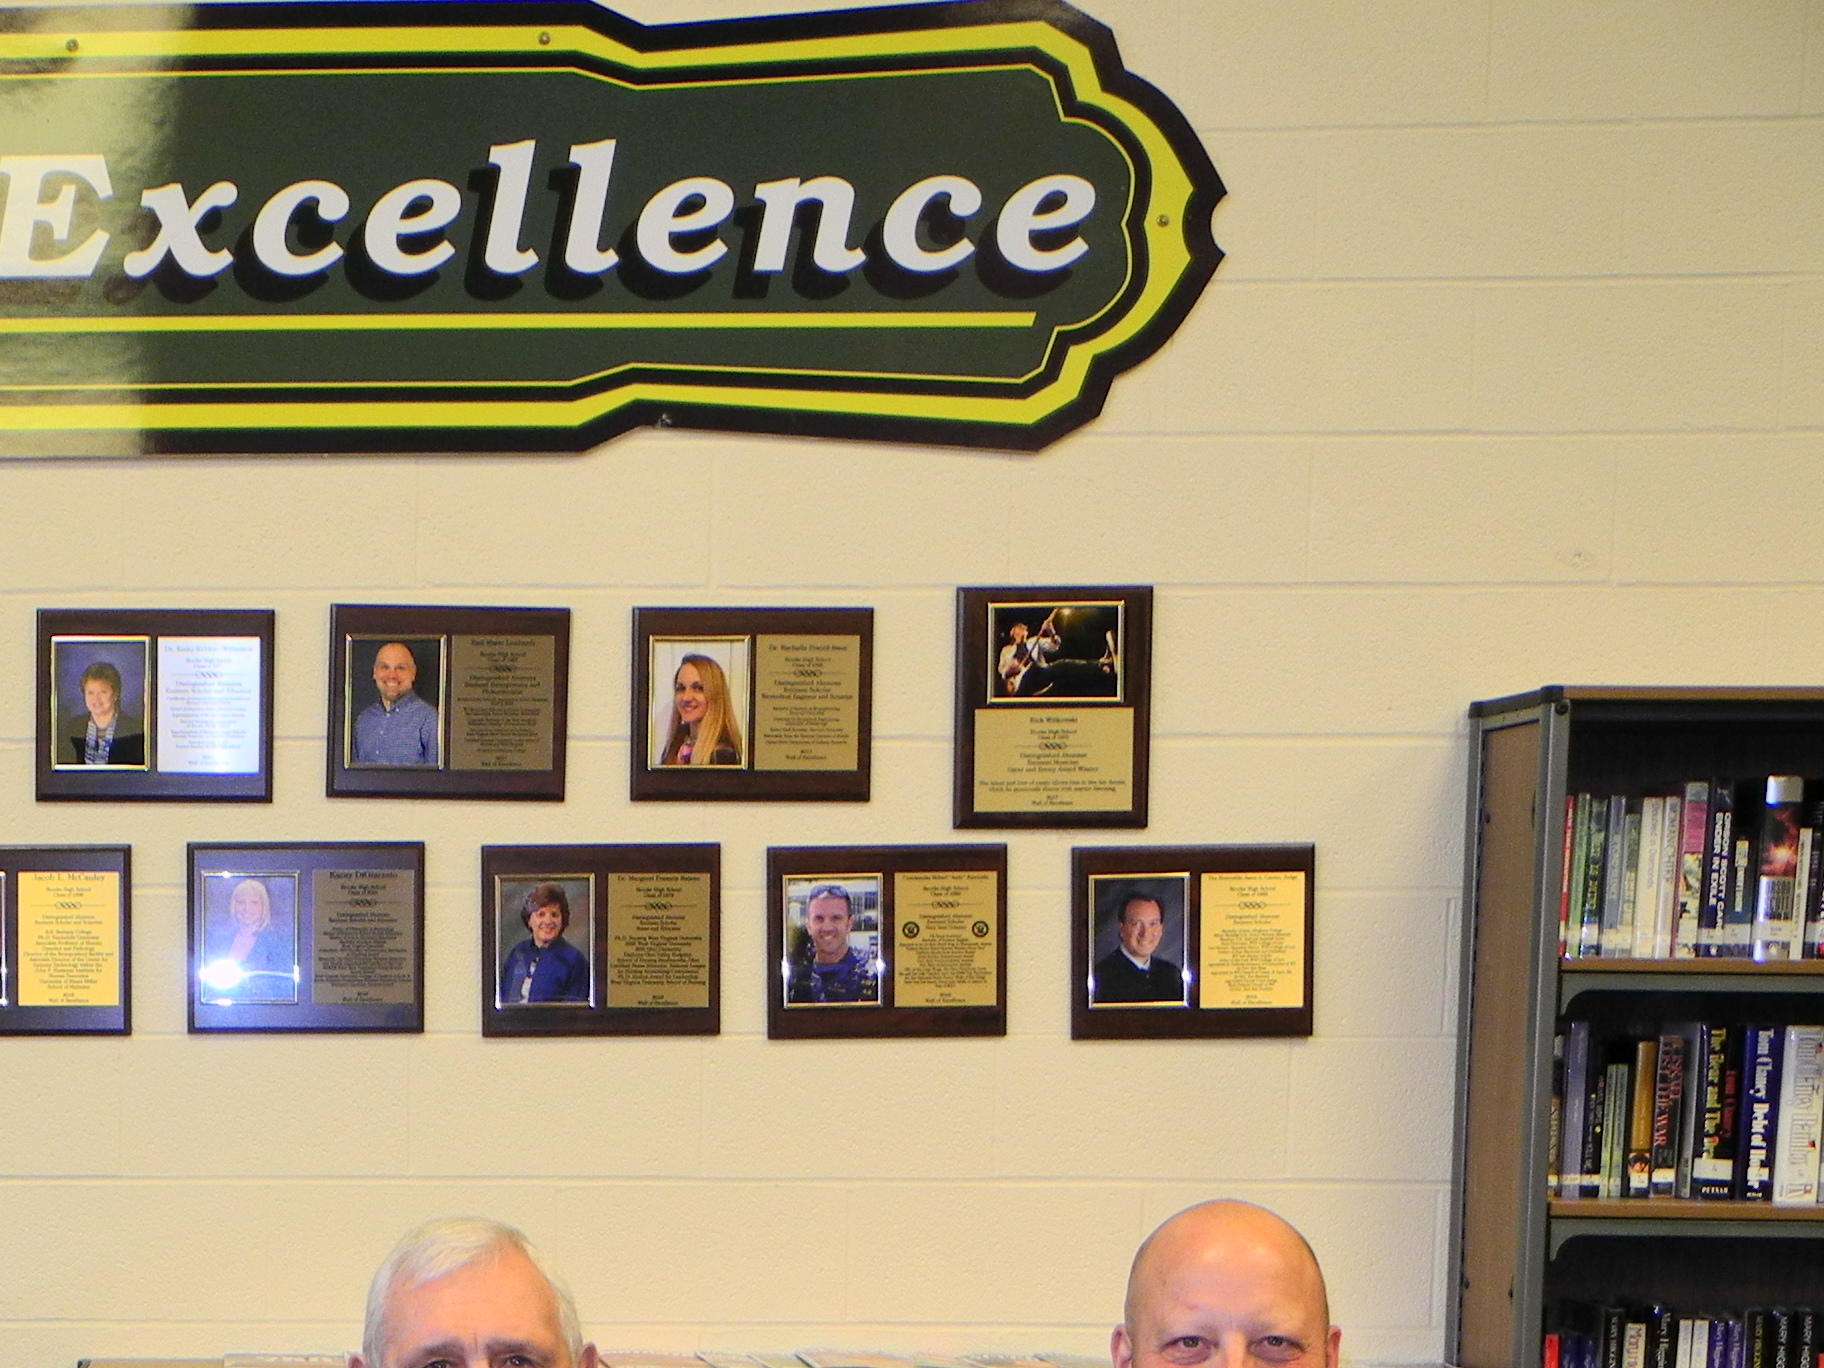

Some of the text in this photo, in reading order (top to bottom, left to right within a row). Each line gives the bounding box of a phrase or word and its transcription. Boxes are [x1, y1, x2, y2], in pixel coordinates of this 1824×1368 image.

[1722, 812, 1731, 855] ORSON
[1709, 812, 1723, 906] ENDER IN EXILE
[1718, 859, 1728, 898] SCOTT
[1712, 1029, 1726, 1050] The
[1758, 1029, 1774, 1054] Tom
[1749, 1057, 1772, 1099] Clancy
[1707, 1085, 1722, 1108] and
[1654, 1114, 1668, 1146] WAR
[1705, 1111, 1721, 1134] The
[1753, 1103, 1770, 1132] Debt
[1778, 1316, 1787, 1343] MARY
[1803, 1316, 1812, 1343] MARY
